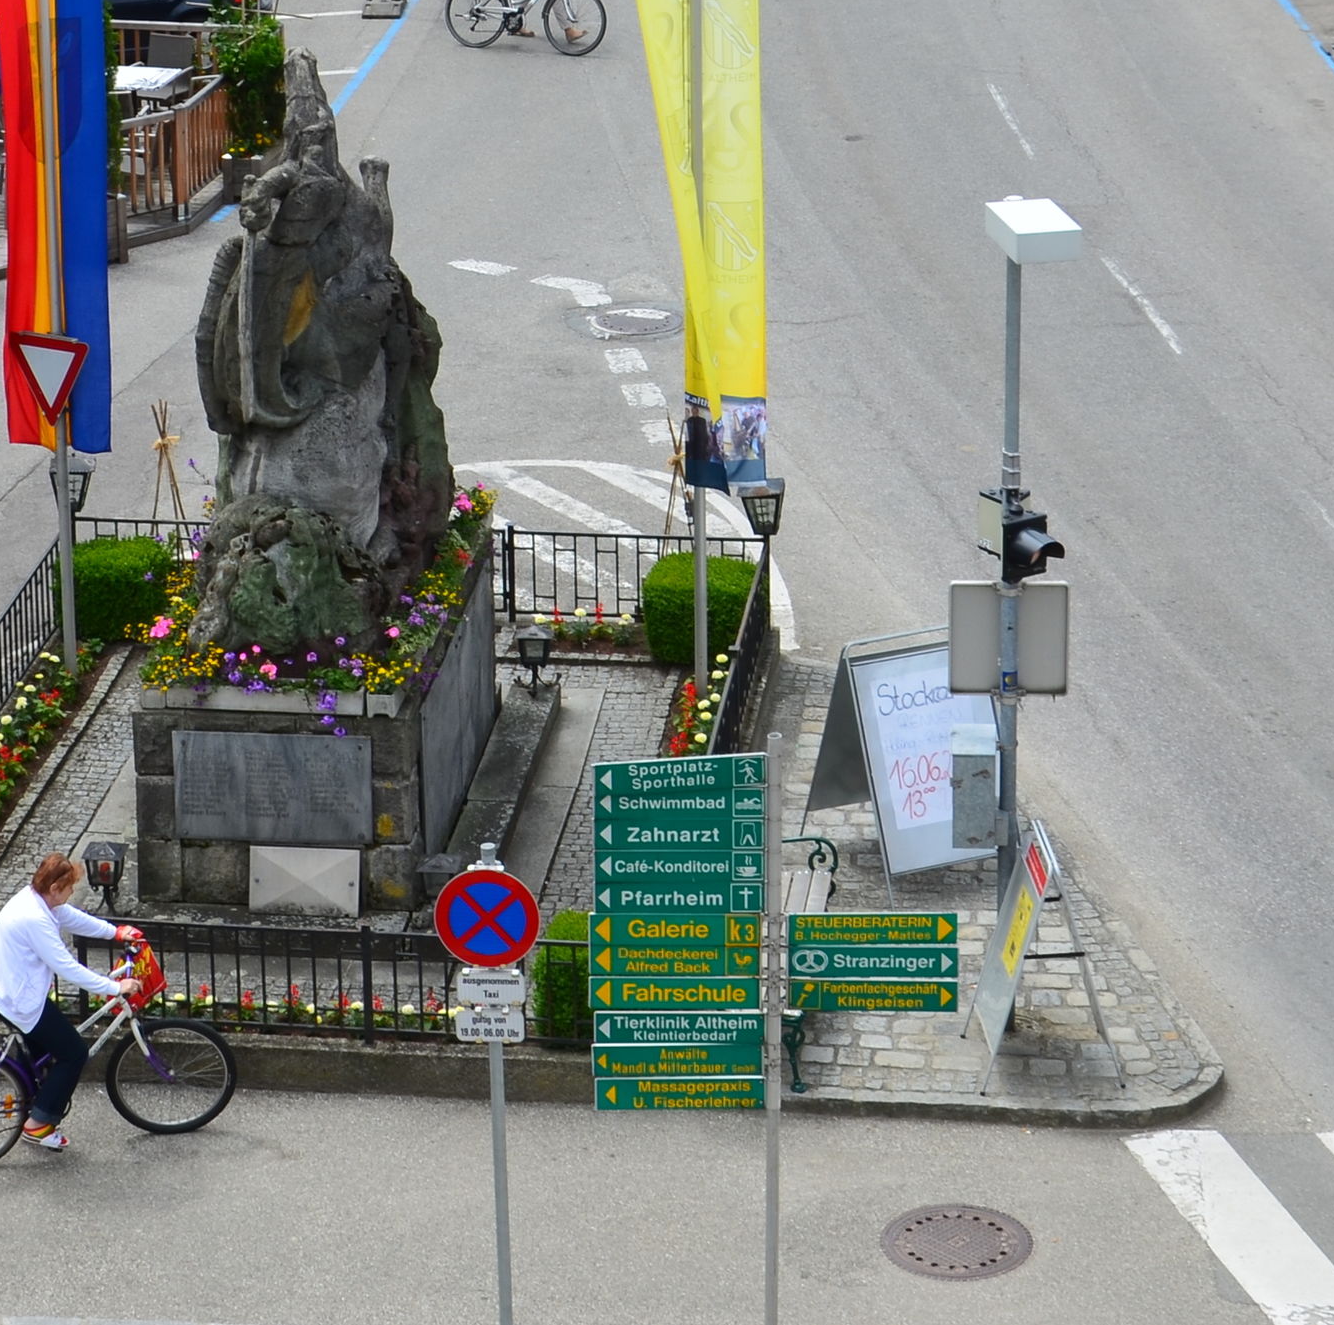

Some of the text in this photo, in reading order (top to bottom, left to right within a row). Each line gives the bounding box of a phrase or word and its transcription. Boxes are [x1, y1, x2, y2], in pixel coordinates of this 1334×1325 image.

[627, 759, 719, 778] Sportplatz-
[631, 773, 715, 791] Sporthalle
[618, 795, 726, 810] Schwimmbad
[626, 827, 720, 844] Zahnarzt
[614, 859, 730, 874] Café-Konditorei
[621, 891, 723, 906] Pfarrheim
[627, 920, 710, 938] Galerie
[795, 917, 932, 929] STEUERBERATERIN
[795, 931, 807, 941] B.
[617, 948, 719, 961] Dachdeckerei
[625, 960, 711, 974] Alfred Back
[833, 954, 936, 972] Stranzinger
[462, 978, 519, 988] ausgenommen
[823, 982, 938, 997] Farbenfachgeschäft
[483, 990, 499, 999] Taxi
[621, 985, 747, 1003] Fahrschule
[837, 996, 923, 1010] Klingseisen
[614, 1016, 758, 1030] Tierklinik Altheim
[507, 1028, 519, 1037] Uhr
[633, 1030, 737, 1042] Kleintierbedarf
[660, 1048, 708, 1060] Anwälte
[612, 1062, 646, 1074] Mandl
[648, 1064, 655, 1073] &
[658, 1062, 726, 1074] Mitterbauer
[638, 1081, 751, 1095] Massagepraxis
[633, 1096, 756, 1109] U. Fischerlehner
